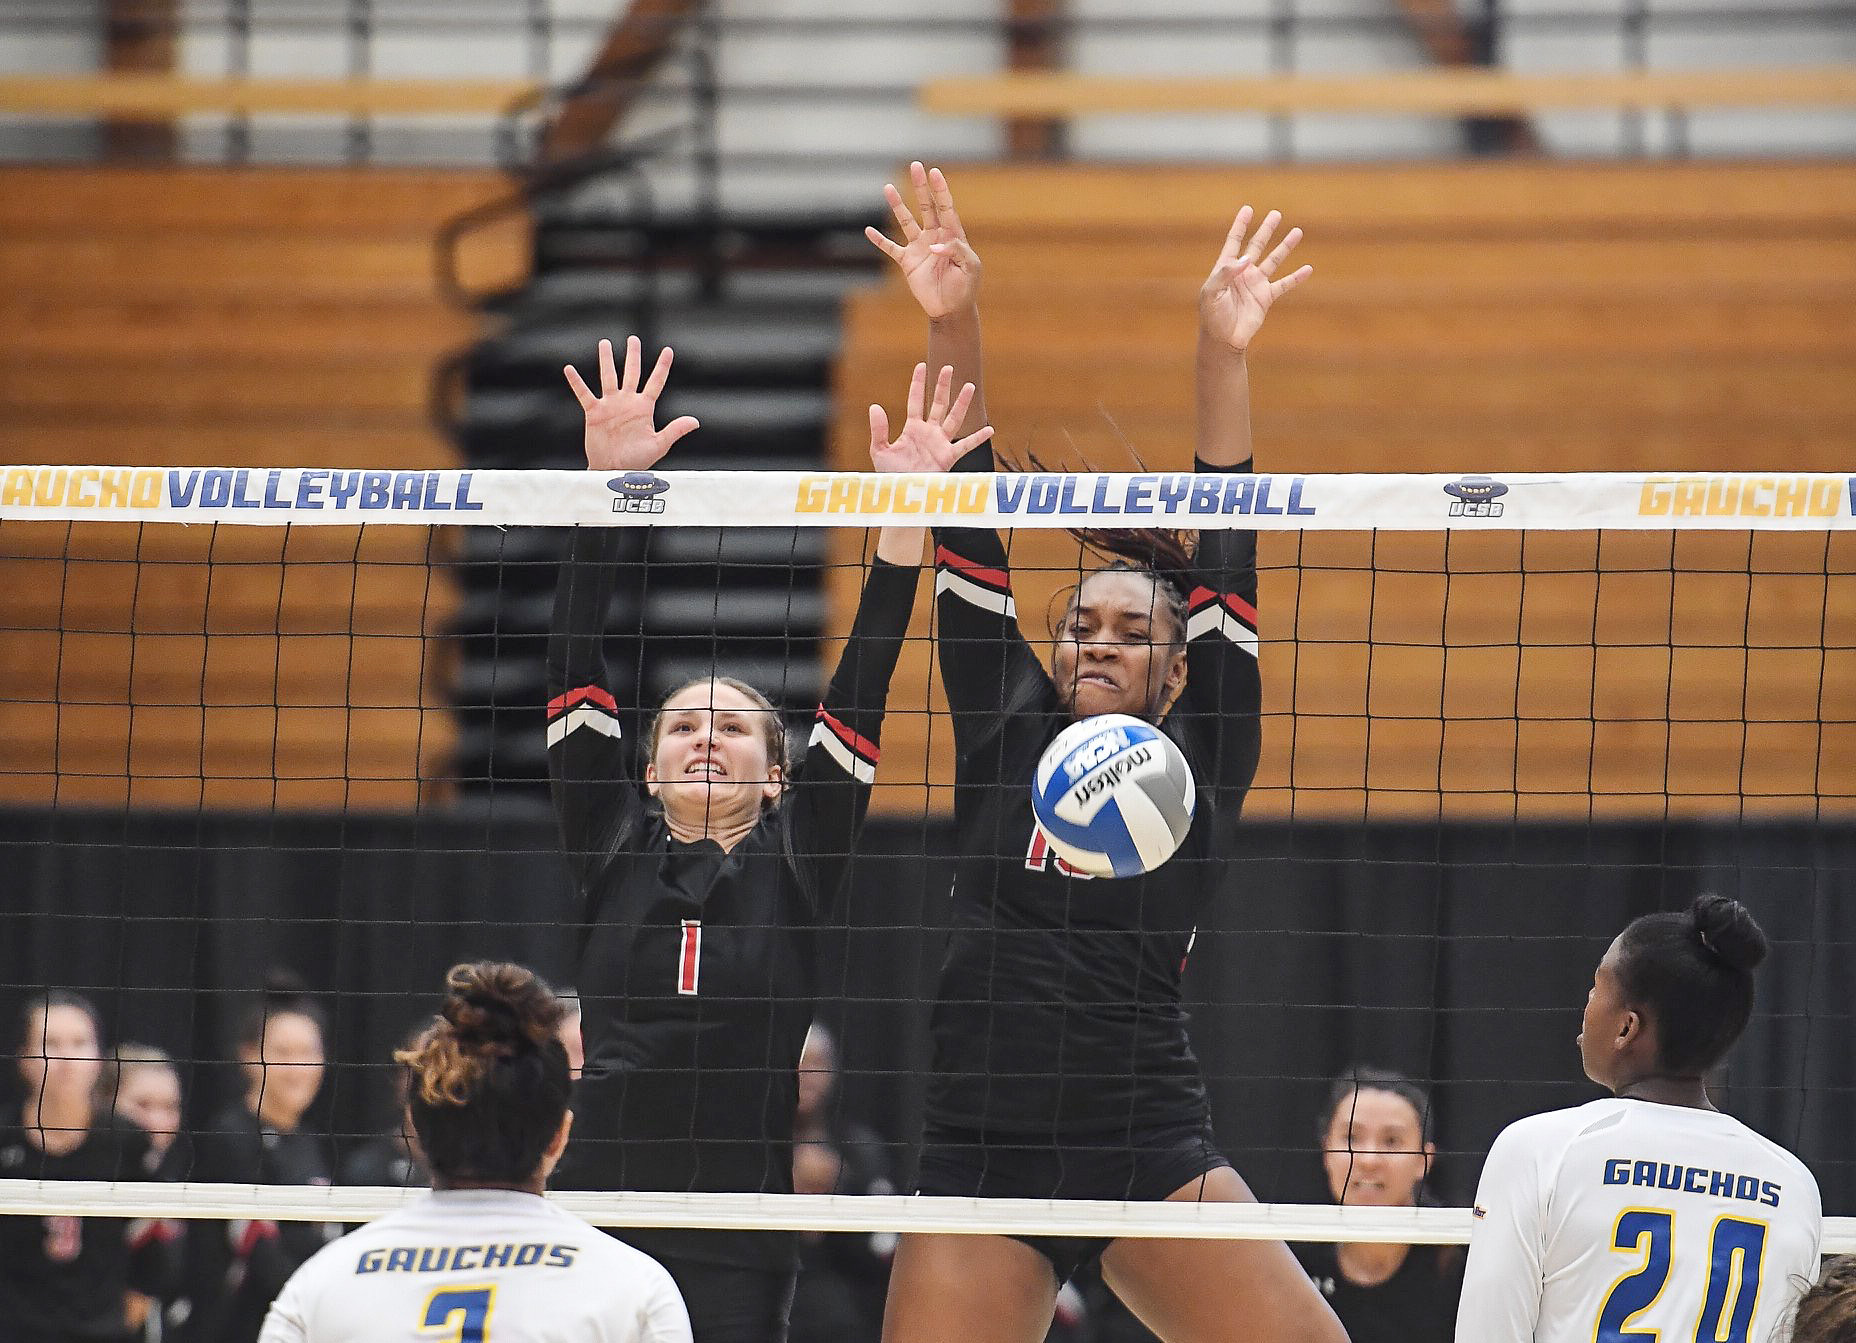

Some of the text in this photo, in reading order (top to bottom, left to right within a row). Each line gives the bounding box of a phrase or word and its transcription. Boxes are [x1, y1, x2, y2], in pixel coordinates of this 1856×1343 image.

[0, 469, 484, 511] AUCHO VOLLEYBALL
[612, 497, 666, 515] UCSB
[794, 475, 1318, 516] GAUCHO VOLLEYBALL
[1449, 502, 1505, 518] UCSB
[1637, 476, 1845, 518] GAUCHO
[1074, 746, 1152, 808] molten
[678, 919, 702, 996] 1
[1602, 1158, 1783, 1208] GAUCHOS
[355, 1242, 580, 1275] GAUCHOS
[1590, 1205, 1771, 1343] 20
